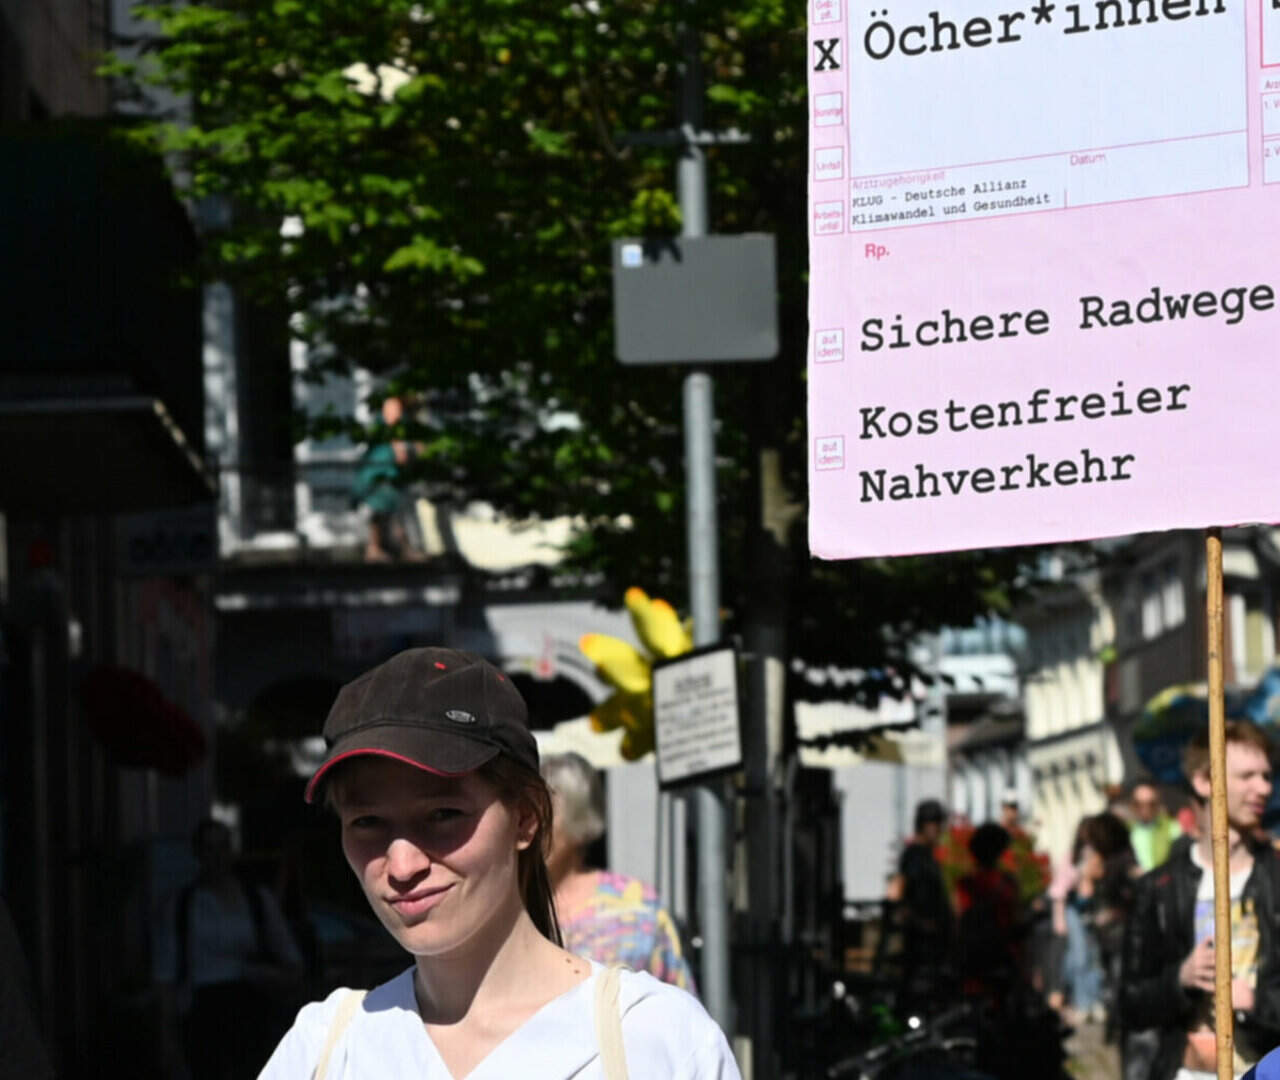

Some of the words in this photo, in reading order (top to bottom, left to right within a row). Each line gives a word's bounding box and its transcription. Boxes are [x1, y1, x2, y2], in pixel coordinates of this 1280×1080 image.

[1070, 152, 1106, 166] Datum
[852, 195, 883, 208] KLUG
[905, 185, 966, 202] Deutsche
[973, 178, 1027, 194] Allianz
[852, 206, 935, 225] Klimawandel
[943, 203, 967, 215] und
[973, 193, 1051, 212] Gesundheit
[864, 243, 890, 260] Rp.
[860, 307, 1050, 352] Sichere
[1079, 284, 1276, 329] Radwege
[859, 381, 1191, 440] Kostenfreier
[858, 449, 1136, 503] Nahverkehr
